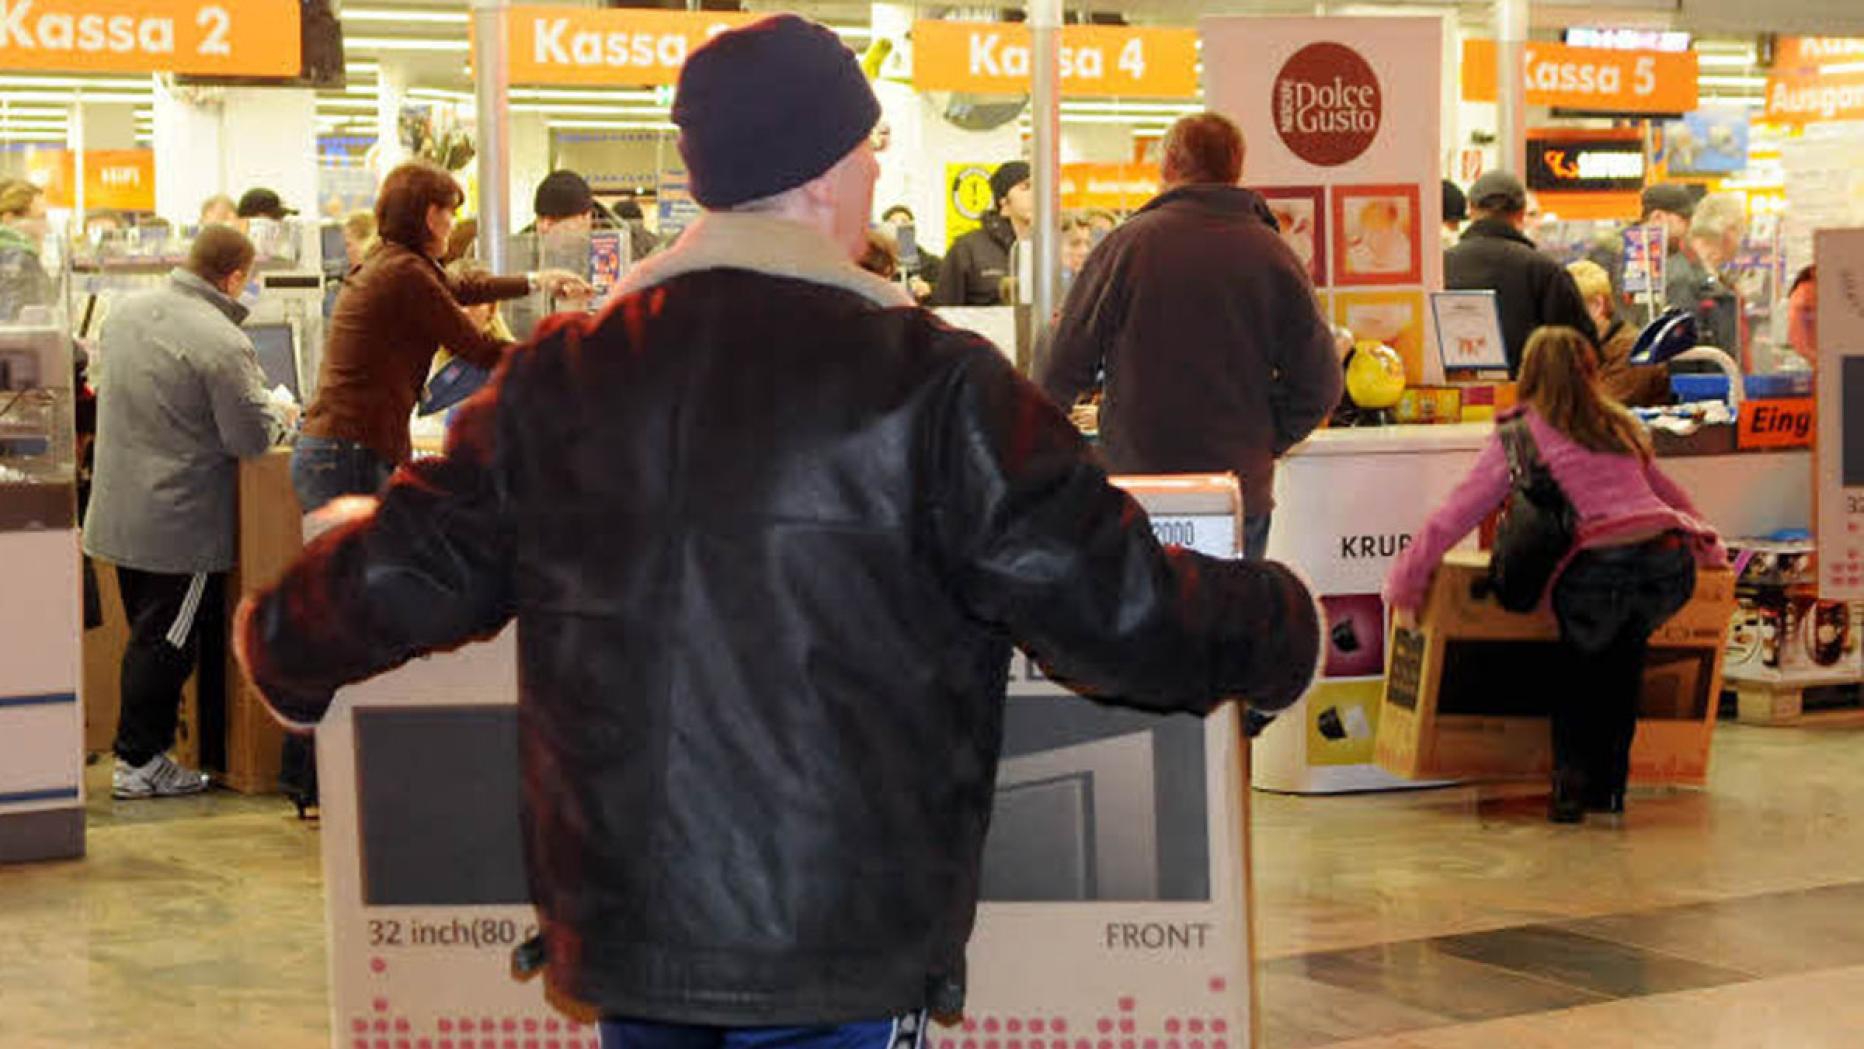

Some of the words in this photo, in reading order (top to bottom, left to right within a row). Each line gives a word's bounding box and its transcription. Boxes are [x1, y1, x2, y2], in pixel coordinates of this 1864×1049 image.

[0, 0, 174, 53] Kassa
[196, 6, 230, 54] 2
[534, 18, 688, 67] Kassa
[969, 33, 1103, 77] Kasa
[1118, 37, 1145, 79] 4
[1633, 57, 1656, 95] 5
[1296, 76, 1375, 109] Dolce
[1296, 106, 1376, 133] Gusto
[1751, 406, 1811, 437] Eing
[1341, 533, 1412, 558] KRUP
[368, 920, 401, 945] 32
[1106, 922, 1212, 950] FRONT
